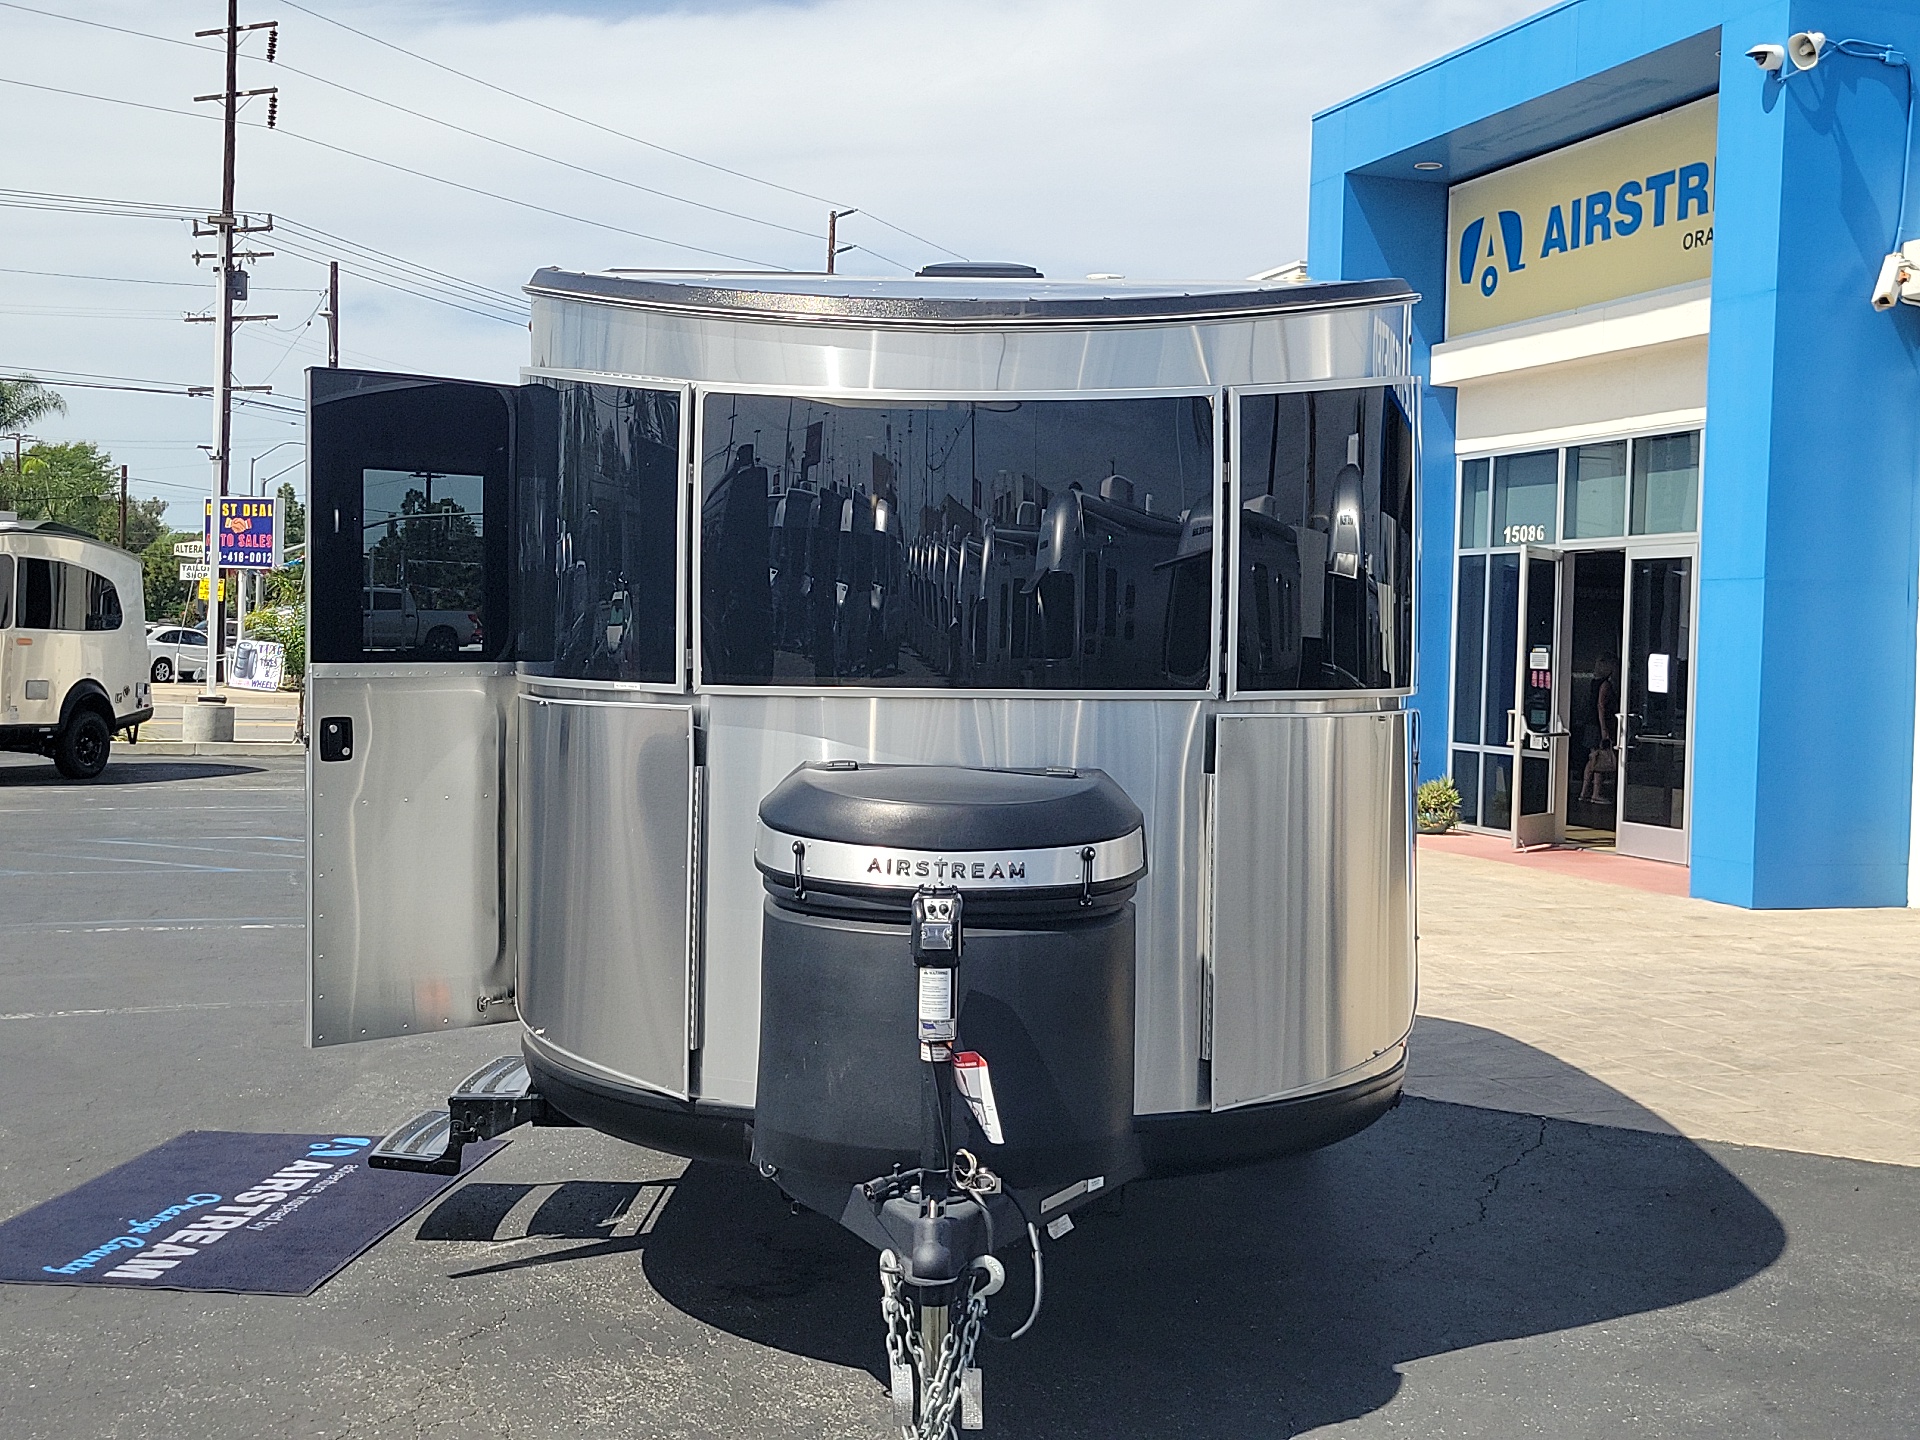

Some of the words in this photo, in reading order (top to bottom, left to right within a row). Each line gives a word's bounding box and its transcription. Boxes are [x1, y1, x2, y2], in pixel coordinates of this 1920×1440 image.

[1540, 156, 1716, 259] AIRSTR
[1682, 226, 1714, 251] ORA
[206, 503, 237, 516] BST
[243, 503, 273, 516] DEAL
[205, 533, 234, 547] ATO
[238, 533, 273, 548] SALES
[1503, 524, 1546, 544] 15086
[175, 544, 203, 554] ALTERA
[205, 551, 272, 563] 74-418-0012
[252, 680, 277, 689] WHEELS
[866, 857, 1026, 880] AIRSTREAM
[102, 1159, 335, 1280] AIRSTREAM
[127, 1193, 222, 1234] Orange
[42, 1236, 146, 1275] County
